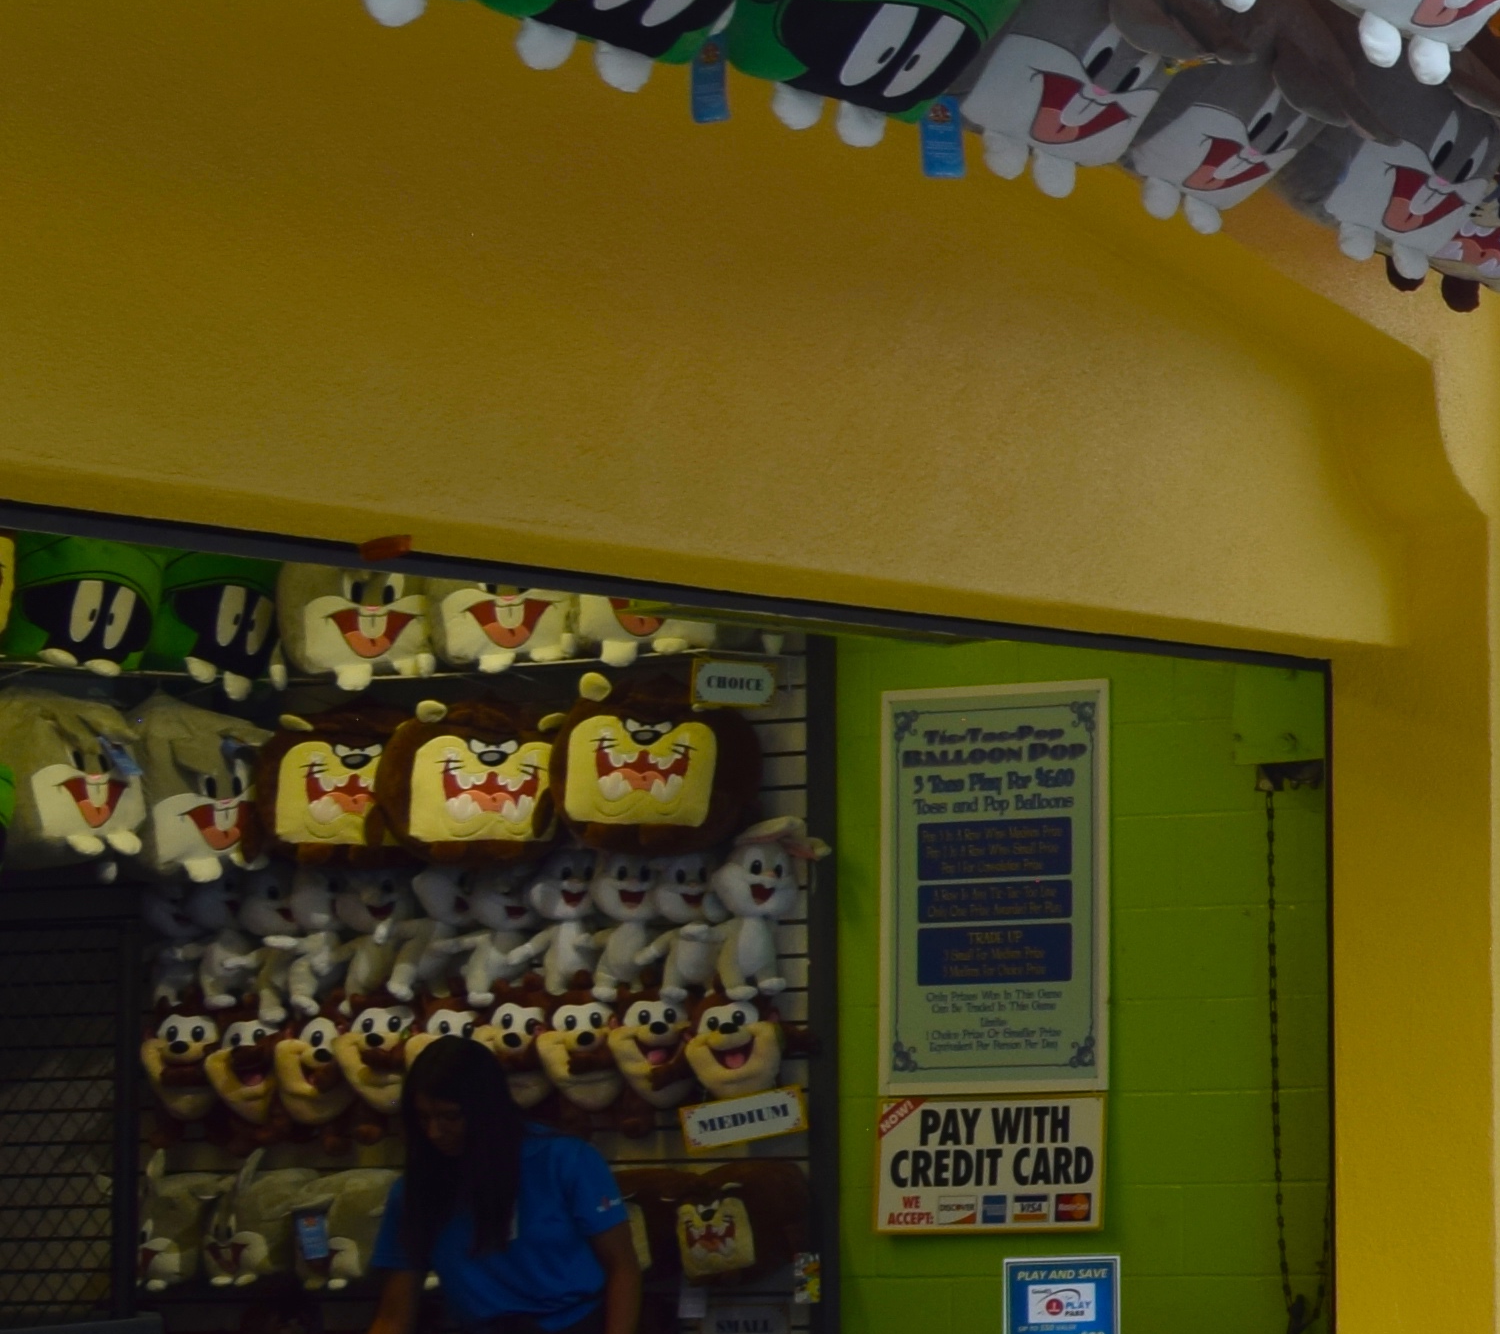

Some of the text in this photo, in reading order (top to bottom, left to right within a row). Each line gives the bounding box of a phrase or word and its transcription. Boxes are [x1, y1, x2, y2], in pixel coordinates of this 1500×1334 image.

[707, 675, 764, 691] CHOICE
[902, 743, 1087, 767] BALLOON POP
[1007, 771, 1032, 789] For
[913, 793, 1075, 815] Toss and Pop Balloons
[968, 930, 1023, 945] TRADE UP
[697, 1102, 790, 1134] MEDIUM
[880, 1100, 915, 1133] NOW!
[920, 1106, 1070, 1146] PAY WITH
[890, 1147, 1094, 1187] CREDIT CARD
[902, 1196, 921, 1209] WE
[939, 1204, 975, 1212] DISCOVER
[1020, 1202, 1043, 1213] VISA
[887, 1212, 935, 1225] ACCEPT:
[1017, 1268, 1108, 1281] PLAY AND SAVE
[1066, 1301, 1091, 1309] PLAY
[716, 1318, 774, 1334] SMALL
